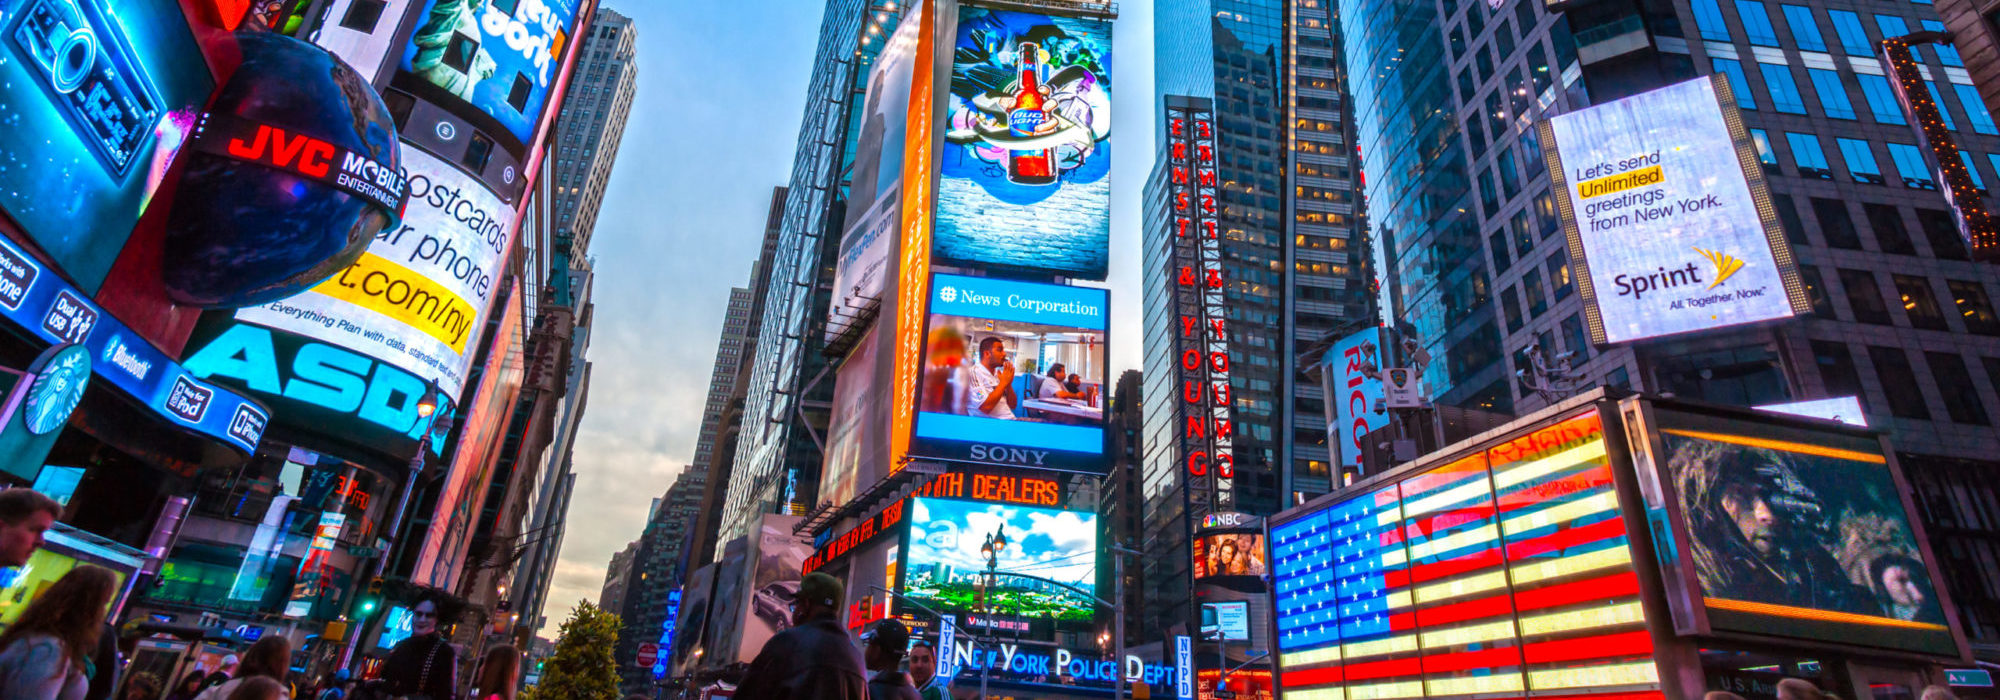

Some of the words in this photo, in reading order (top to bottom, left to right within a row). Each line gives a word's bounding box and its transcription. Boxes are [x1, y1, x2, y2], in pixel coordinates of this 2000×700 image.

[228, 124, 336, 178] JVC
[1576, 163, 1612, 182] Let's
[1619, 150, 1661, 174] send
[337, 173, 399, 210] ENTERTAINMENT
[342, 151, 405, 199] MOBILE
[1171, 118, 1191, 238] ERNST
[1580, 167, 1660, 198] Unlimited
[399, 165, 508, 255] ostcards
[1585, 189, 1665, 218] greetings
[1589, 213, 1629, 233] from
[1635, 201, 1673, 224] New
[1677, 193, 1723, 214] York.
[408, 234, 491, 301] phone.
[1178, 265, 1196, 287] &
[1614, 262, 1702, 300] Sprint
[57, 297, 78, 318] Dual
[904, 264, 914, 329] unique
[961, 289, 1001, 308] News
[1007, 293, 1098, 318] Corporation
[48, 312, 67, 331] USB
[270, 301, 335, 328] Everything
[336, 319, 362, 335] Plan
[363, 328, 386, 344] with
[385, 336, 407, 353] data,
[408, 347, 440, 368] standard
[112, 344, 151, 381] Bluetooth
[177, 397, 202, 417] iPod
[1181, 316, 1209, 476] YOUNG
[1343, 345, 1369, 464] RICO
[970, 445, 1048, 465] SONY
[973, 474, 1059, 506] DEALERS
[1217, 513, 1242, 526] NBC
[939, 613, 954, 676] NYPD
[1000, 643, 1050, 675] YORK
[1056, 648, 1117, 682] POLICE
[1125, 655, 1175, 686] DEPT
[1180, 638, 1189, 696] NYPD
